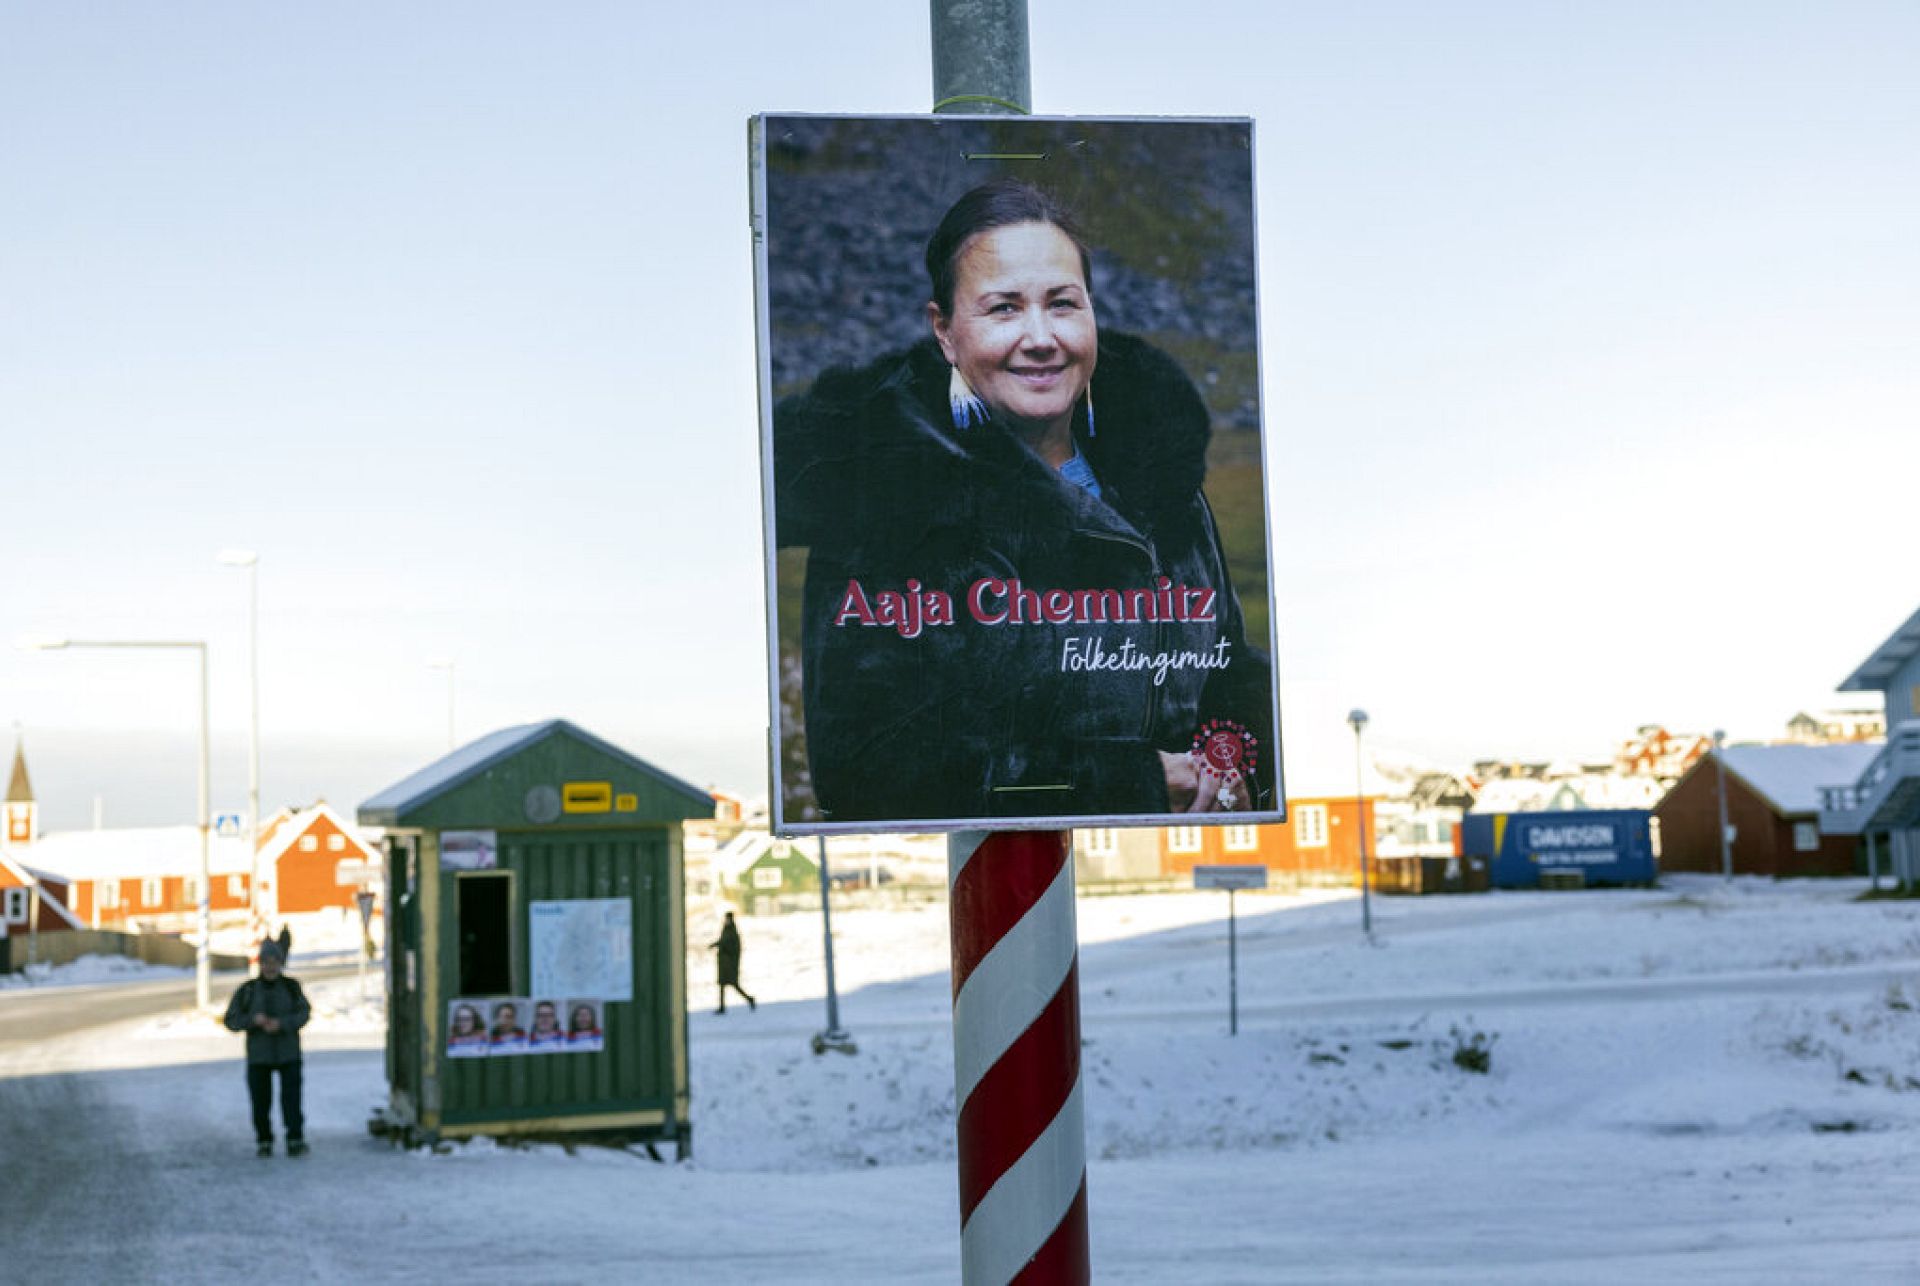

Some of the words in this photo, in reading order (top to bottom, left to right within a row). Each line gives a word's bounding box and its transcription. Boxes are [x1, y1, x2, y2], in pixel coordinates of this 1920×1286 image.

[834, 578, 954, 639] Aaja
[967, 575, 1217, 625] Chemnitz
[1061, 635, 1232, 686] Folketingimut
